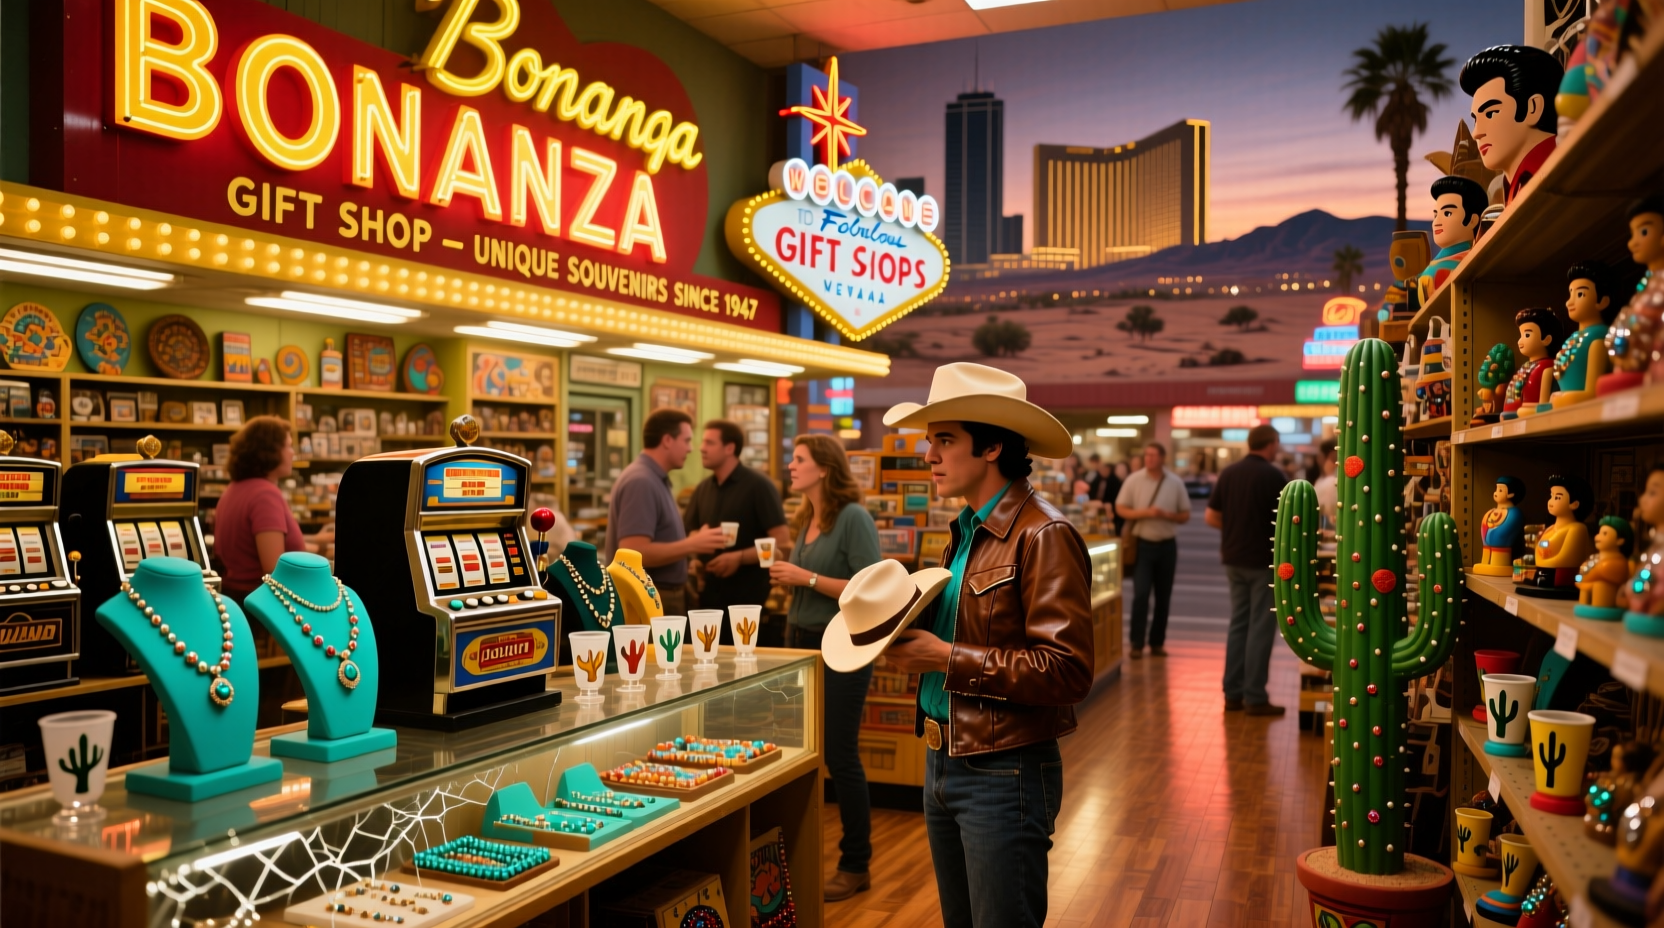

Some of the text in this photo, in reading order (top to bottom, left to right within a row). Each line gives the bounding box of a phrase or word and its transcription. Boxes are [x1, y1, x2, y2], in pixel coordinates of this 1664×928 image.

[114, 0, 667, 263] BONANZA
[227, 176, 323, 229] GIFT
[338, 201, 432, 252] SHOP
[474, 234, 559, 279] UNIQUE
[567, 255, 668, 303] SOUVENIRS
[674, 281, 720, 313] SINCE
[724, 293, 759, 320] 1947
[775, 226, 841, 273] GIFT
